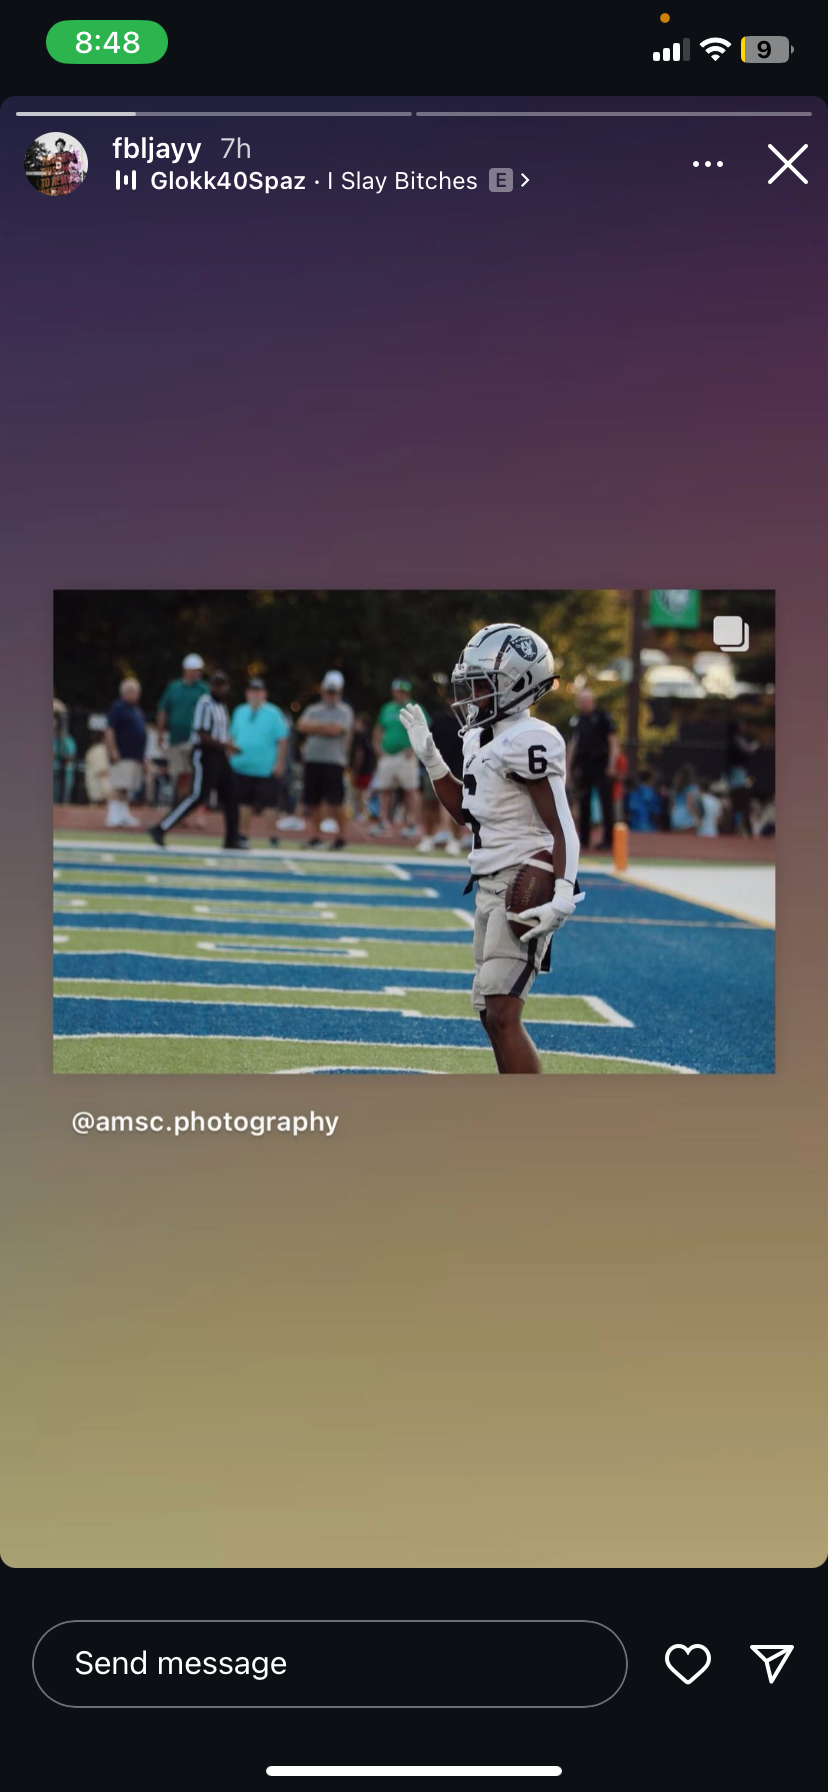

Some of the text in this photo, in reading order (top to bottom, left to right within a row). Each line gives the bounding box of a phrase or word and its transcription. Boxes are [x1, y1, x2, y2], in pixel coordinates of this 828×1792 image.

[75, 31, 140, 54] 8:48
[757, 40, 771, 59] 9
[112, 136, 251, 163] fbljayy 7h
[150, 170, 507, 195] Glokk40Spaz I Slay Bitches E
[527, 745, 548, 774] 6
[75, 1649, 287, 1681] Send message
